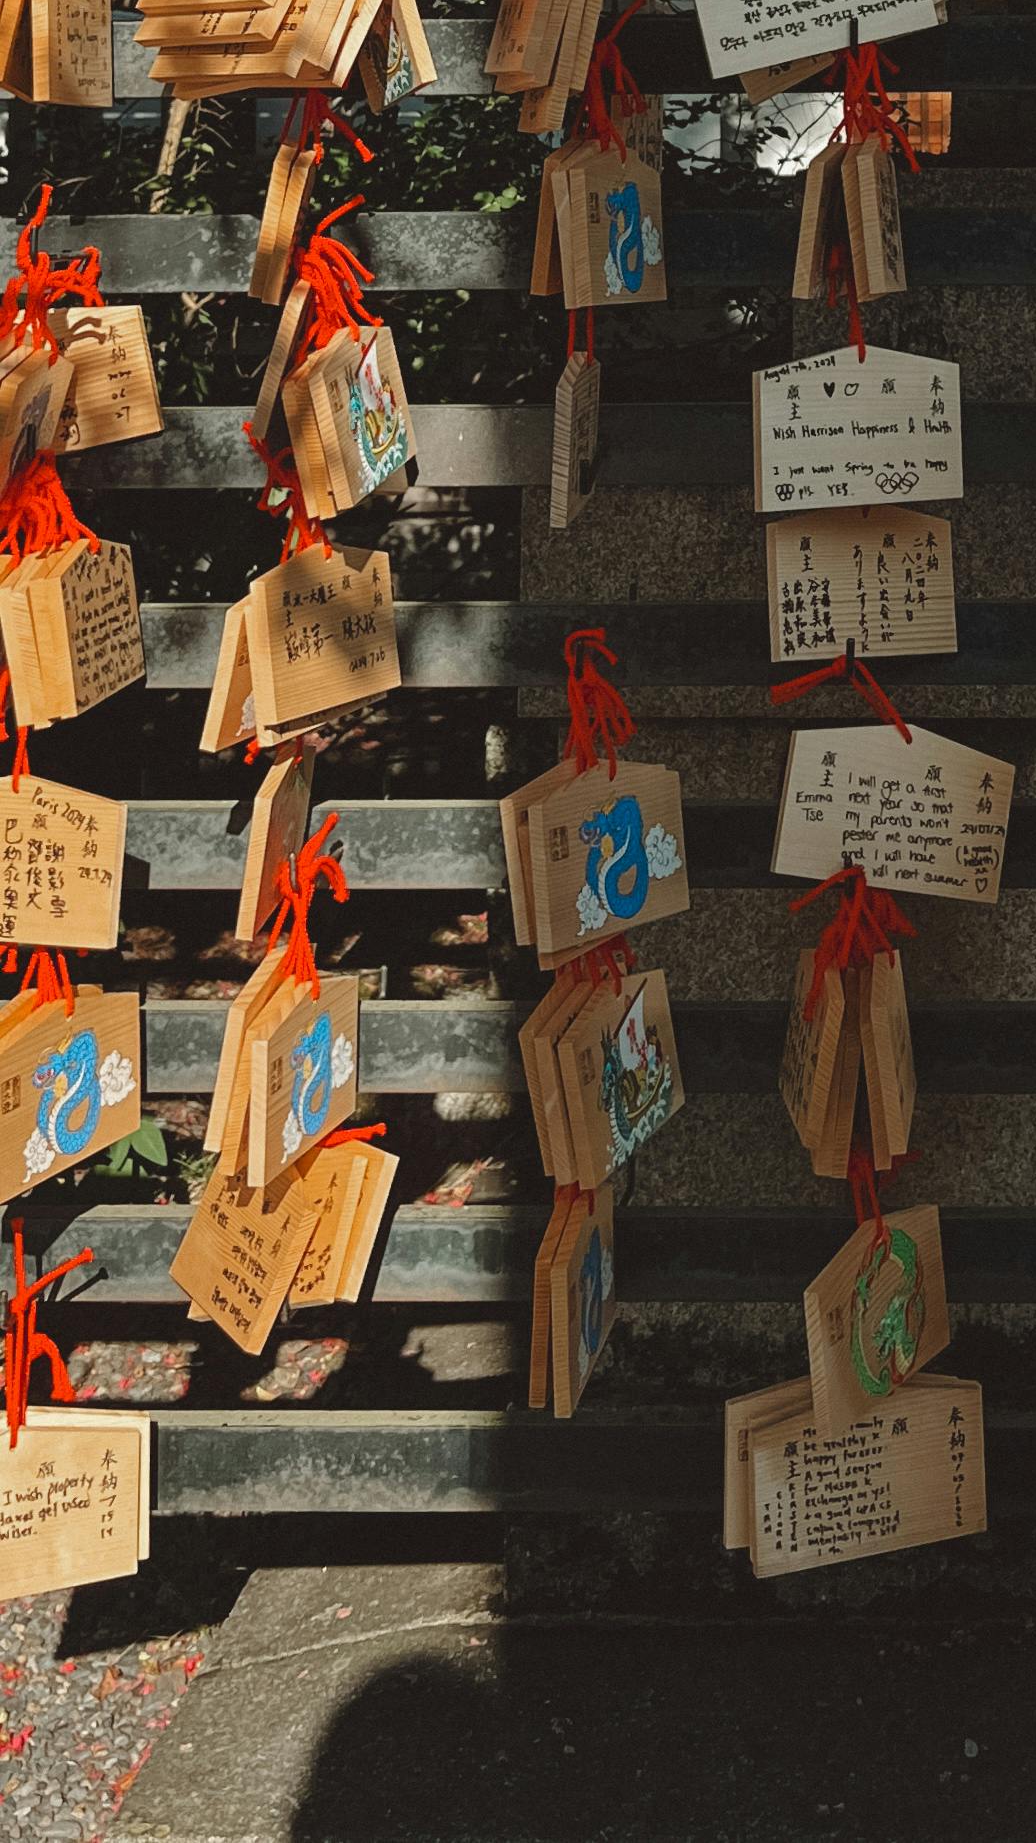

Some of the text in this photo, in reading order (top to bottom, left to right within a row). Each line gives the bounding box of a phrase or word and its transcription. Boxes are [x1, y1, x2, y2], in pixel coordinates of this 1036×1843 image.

[753, 25, 783, 42] 아프지
[107, 325, 127, 364] 奉納
[764, 364, 790, 383] August
[881, 378, 897, 395] 願
[786, 384, 802, 420] 願主
[930, 375, 945, 416] 奉納
[802, 423, 844, 439] Harrison
[852, 420, 898, 440] Happiness
[772, 466, 780, 475] I
[789, 465, 804, 479] just
[812, 464, 834, 474] want
[845, 461, 874, 476] Spring
[883, 461, 895, 470] to
[925, 458, 949, 472] happy
[925, 530, 939, 572] 奉納
[853, 544, 870, 653] ありますように
[877, 551, 895, 643] 良い出会いが
[902, 552, 916, 622] 八月九日
[796, 790, 833, 804] Emma
[848, 772, 947, 801] I will get a first
[976, 772, 994, 814] 奉納
[32, 786, 86, 831] Paris 2024
[803, 808, 824, 821] Tse
[849, 791, 871, 805] next
[879, 797, 903, 816] year
[911, 801, 925, 813] so
[846, 811, 950, 829] my parents won't
[82, 815, 98, 859] 奉納
[842, 829, 953, 852] pester me anymore
[841, 847, 865, 861] and
[885, 851, 901, 862] will
[909, 850, 936, 865] have
[896, 867, 969, 887] next summer
[948, 1406, 966, 1449] 奉納
[101, 1449, 118, 1493] 奉納
[804, 1452, 837, 1467] happy
[3, 1472, 94, 1505] I wish property
[38, 1503, 57, 1522] get
